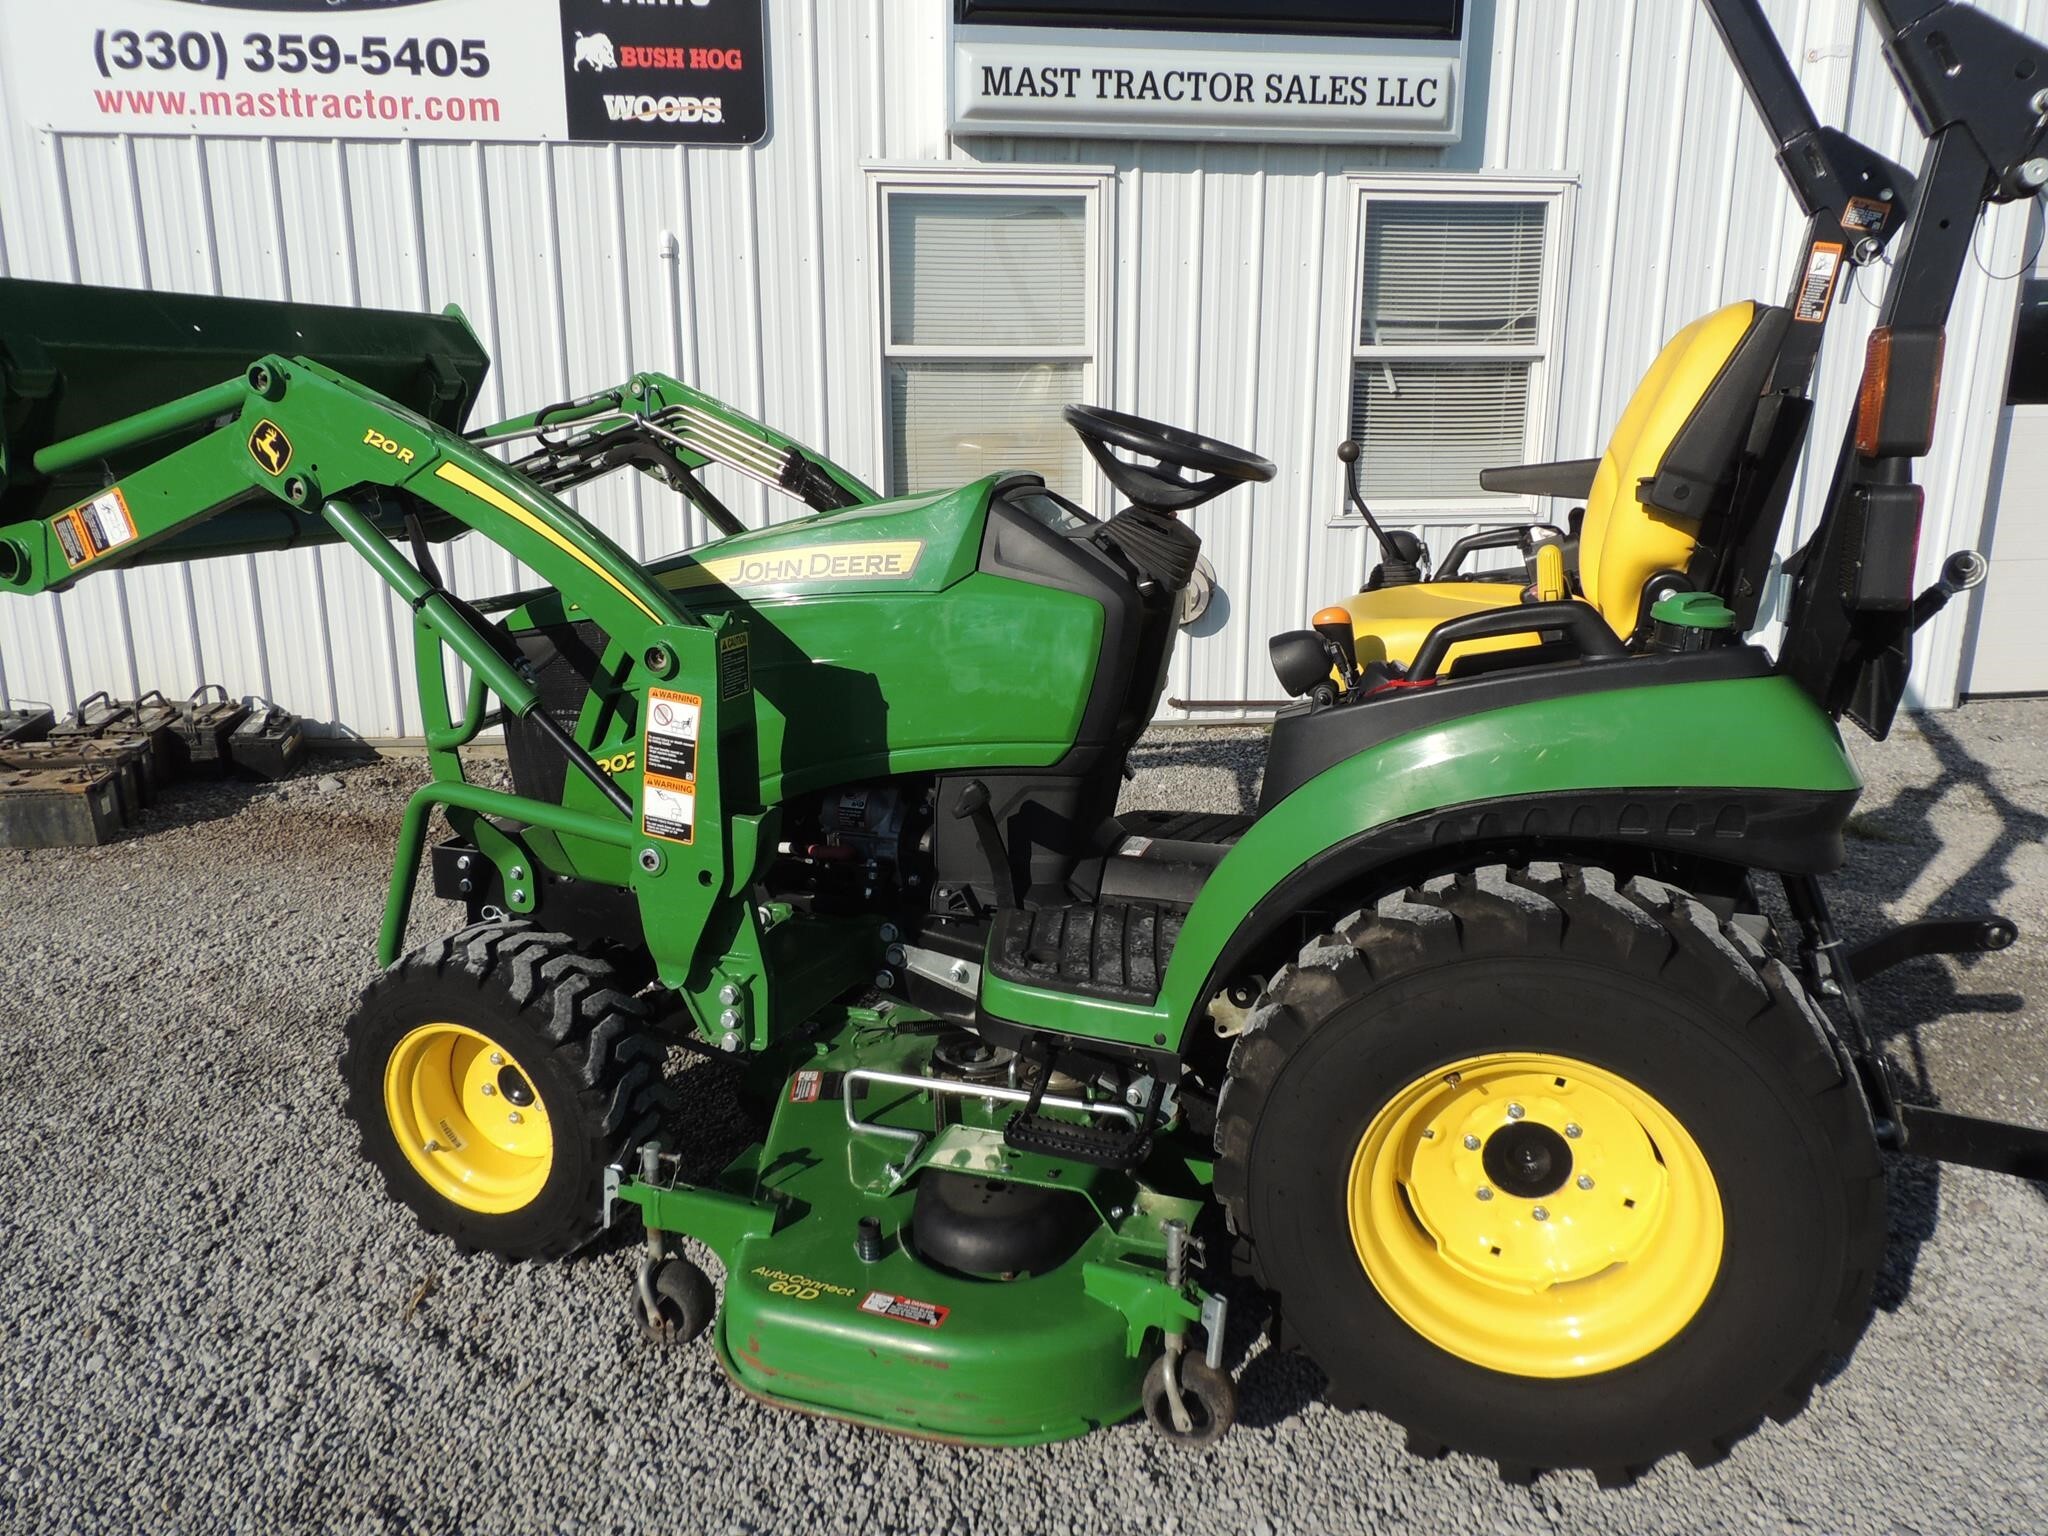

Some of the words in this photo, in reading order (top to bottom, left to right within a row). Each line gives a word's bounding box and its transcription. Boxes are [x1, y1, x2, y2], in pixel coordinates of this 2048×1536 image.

[94, 28, 228, 80] (330)
[243, 33, 491, 78] 359-5405
[620, 46, 685, 69] BUSH
[689, 48, 743, 70] HOG
[981, 66, 1081, 98] MAST
[1092, 69, 1255, 103] TRACTOR
[1265, 74, 1368, 106] SALES
[1376, 77, 1438, 108] LLC
[94, 87, 500, 122] www.masttractor.com
[602, 94, 723, 123] WOODS
[728, 558, 803, 583] JOHN
[809, 553, 902, 576] DEERE
[659, 690, 699, 705] WARNING
[653, 778, 693, 794] WARNING
[752, 1266, 856, 1297] AutoConnect
[768, 1281, 819, 1300] 60D
